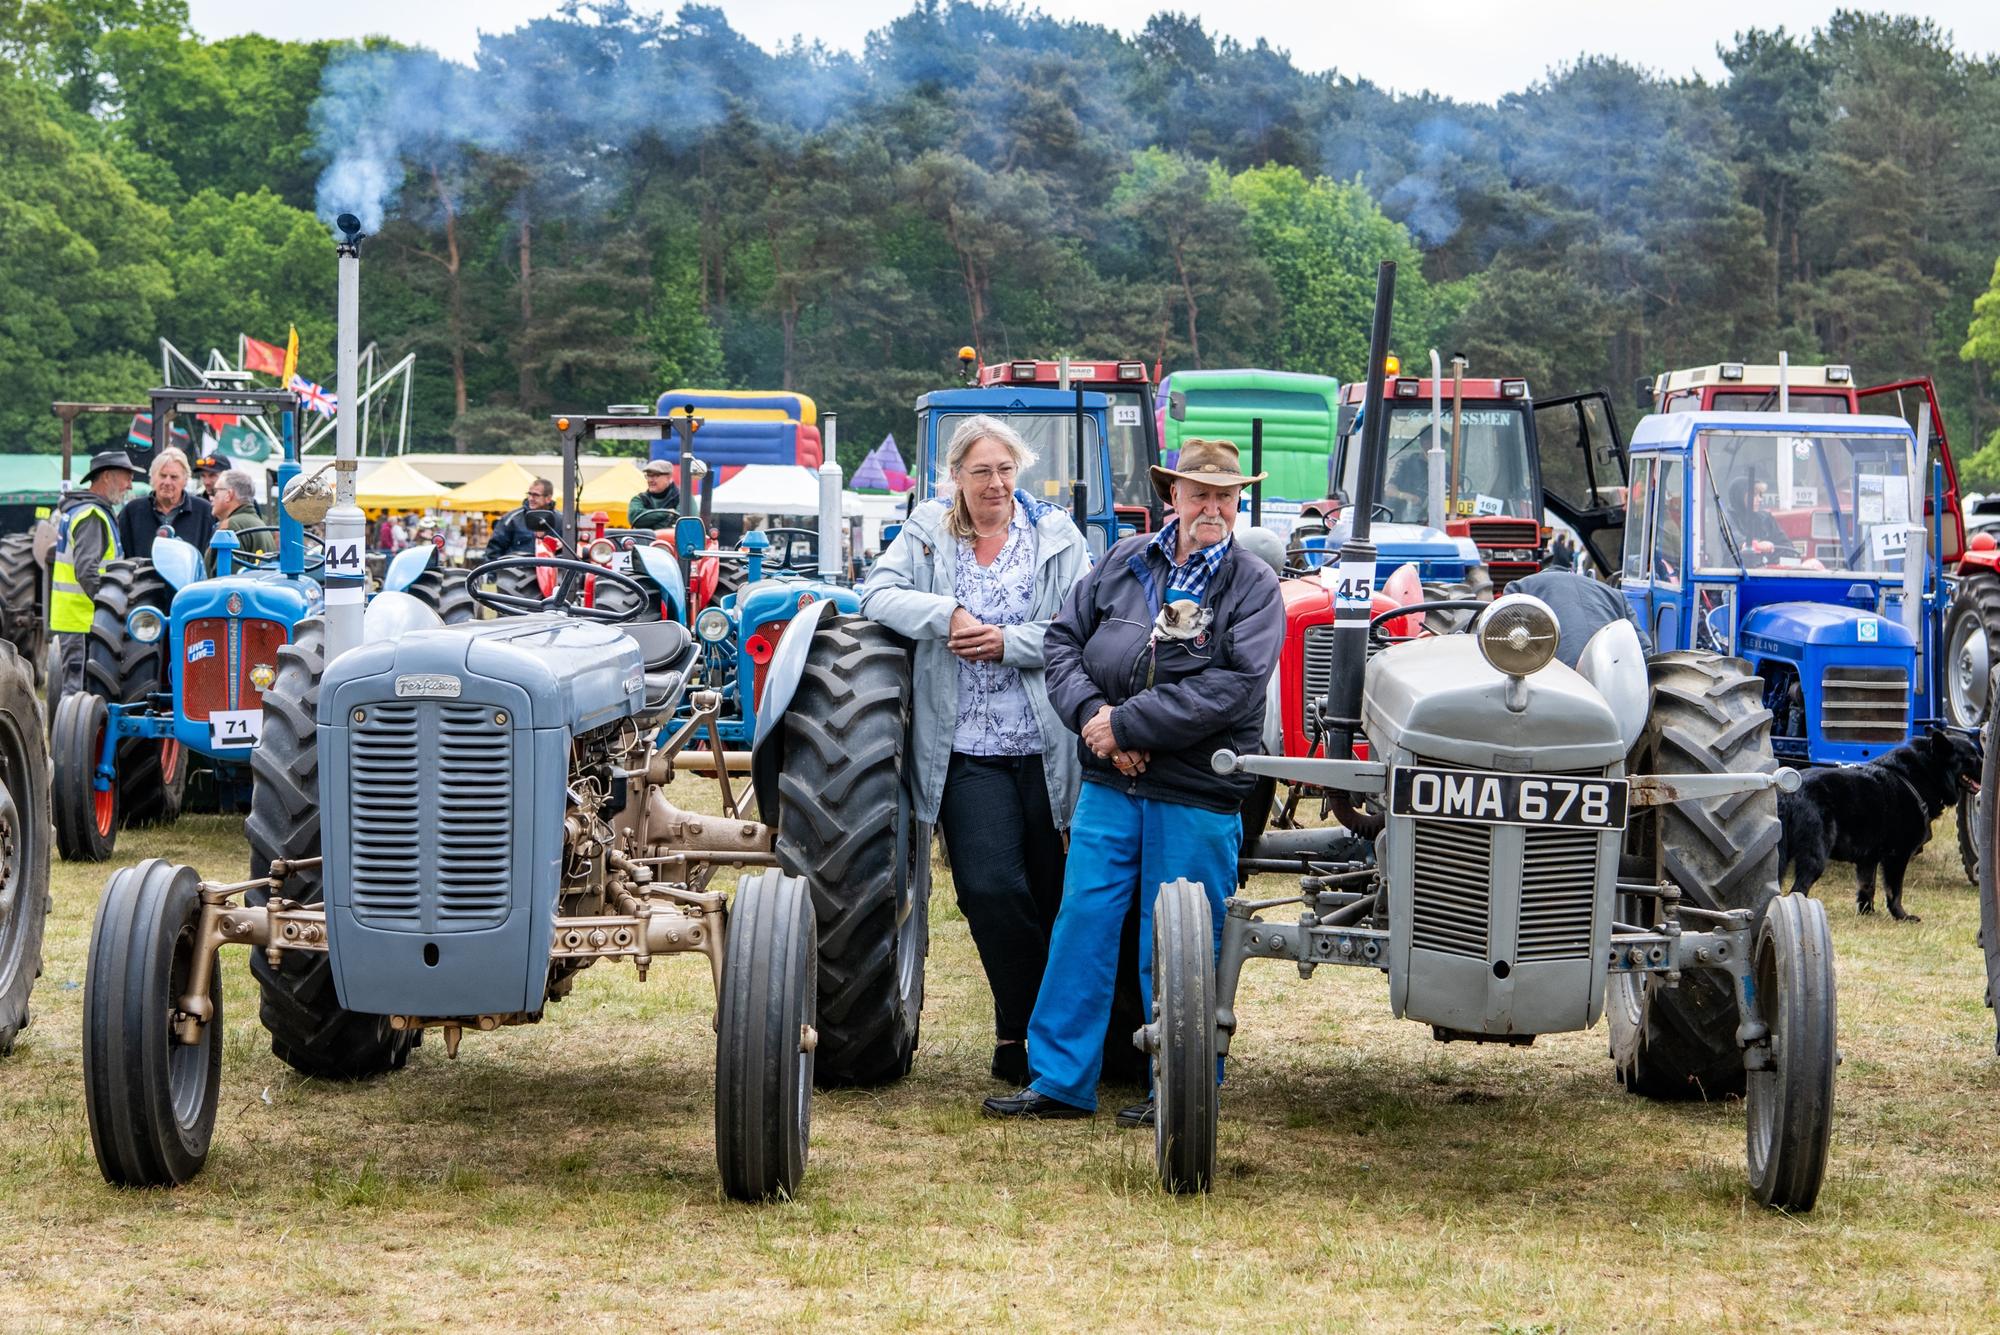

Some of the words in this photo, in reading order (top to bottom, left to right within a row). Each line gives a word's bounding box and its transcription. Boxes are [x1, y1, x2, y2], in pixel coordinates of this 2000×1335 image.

[1119, 410, 1135, 418] 113
[1481, 501, 1498, 511] 169
[1881, 532, 1907, 546] 11
[325, 544, 360, 569] 44
[1338, 578, 1370, 601] 45
[399, 679, 460, 695] Ferguson
[225, 720, 247, 734] 71
[1411, 773, 1504, 818] OMA
[1518, 780, 1610, 824] 678
